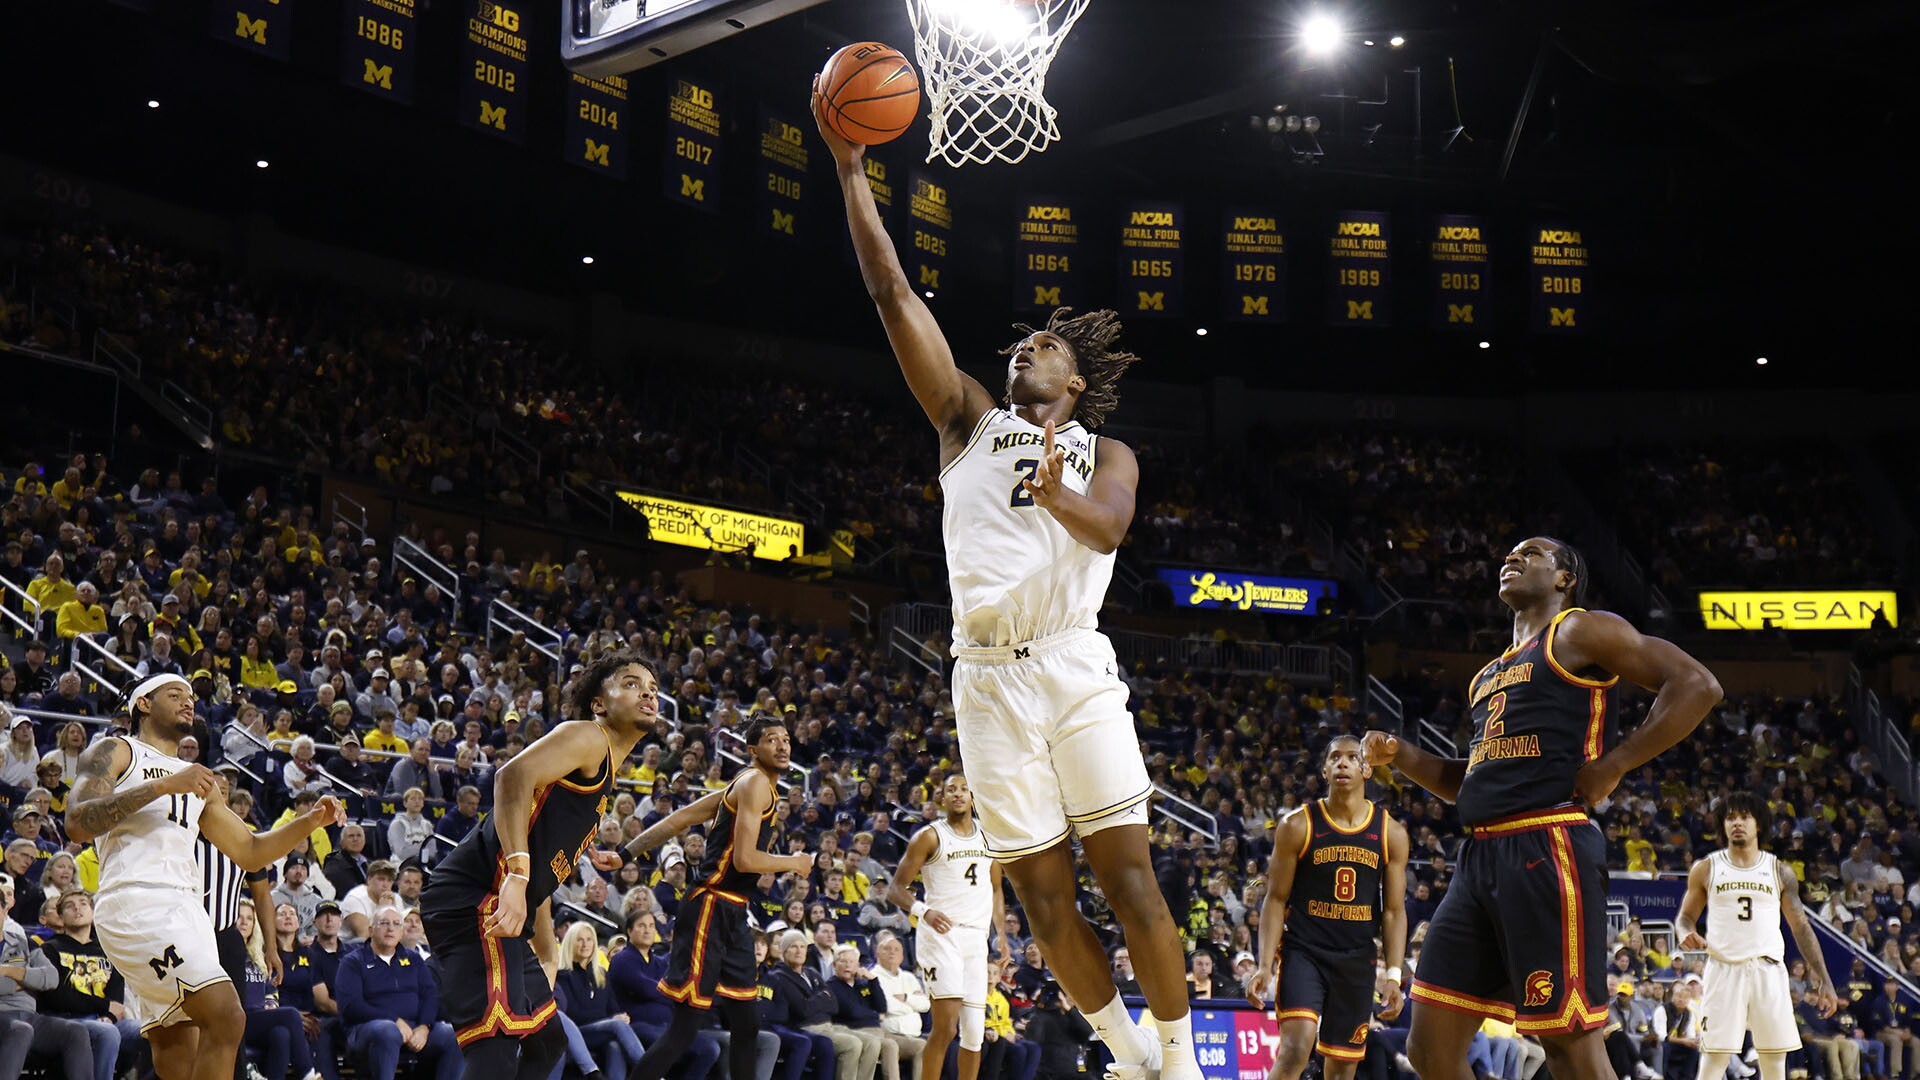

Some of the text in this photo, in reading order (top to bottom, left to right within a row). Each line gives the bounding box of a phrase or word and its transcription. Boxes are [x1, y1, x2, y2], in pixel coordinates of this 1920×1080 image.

[236, 11, 267, 45] M
[357, 15, 404, 51] 1986
[469, 18, 528, 52] CHAMPIONS
[363, 57, 393, 90] M
[475, 59, 516, 93] 2012
[480, 100, 508, 131] M
[579, 99, 618, 131] 2014
[584, 137, 610, 167] M
[676, 136, 713, 166] 2017
[681, 173, 705, 202] M
[768, 172, 800, 201] 2018
[771, 208, 795, 236] M
[1028, 205, 1071, 221] NCAA
[1131, 211, 1174, 227] NCAA
[1020, 222, 1077, 236] FINAL FOUR
[1123, 227, 1181, 241] FINAL FOUR
[1233, 217, 1276, 232] NCAA
[1338, 222, 1380, 237] NCAA
[1438, 226, 1481, 241] NCAA
[1227, 232, 1283, 246] FINAL FOUR
[1331, 238, 1388, 250] FINAL FOUR
[1540, 230, 1582, 245] NCAA
[1432, 242, 1488, 254] FINAL FOUR
[1532, 246, 1589, 258] FINAL FOUR
[1027, 253, 1070, 273] 1964
[1131, 259, 1173, 278] 1965
[1234, 264, 1276, 282] 1976
[920, 264, 940, 289] M
[1340, 269, 1380, 287] 1989
[1440, 272, 1480, 291] 2013
[1542, 276, 1582, 294] 2018
[1034, 285, 1061, 306] M
[1138, 291, 1165, 311] M
[1242, 295, 1269, 315] M
[1347, 300, 1374, 320] M
[1447, 304, 1474, 324] M
[1549, 307, 1576, 327] M
[992, 432, 1092, 482] MICHAN
[1010, 458, 1041, 508] 2
[648, 516, 767, 548] CREDIT UNION
[710, 512, 729, 525] OF
[733, 516, 801, 538] MICHIGAN
[1712, 601, 1884, 620] NISSAN
[213, 655, 231, 670] M
[1014, 647, 1030, 660] M
[1484, 690, 1508, 741] 2
[168, 794, 189, 829] 11
[381, 802, 396, 814] M
[947, 849, 986, 862] MICHIGA
[1314, 845, 1380, 870] SOUTHERN
[965, 863, 977, 886] 4
[1334, 866, 1357, 902] 8
[1716, 881, 1773, 895] MICHIGAN
[1633, 895, 1677, 908] TUNNEL
[1737, 896, 1752, 922] 3
[149, 943, 184, 981] M
[298, 955, 310, 967] M
[924, 966, 937, 981] M
[1209, 1032, 1228, 1044] HALF
[1237, 1030, 1259, 1055] 13
[1198, 1047, 1226, 1066] 8:08
